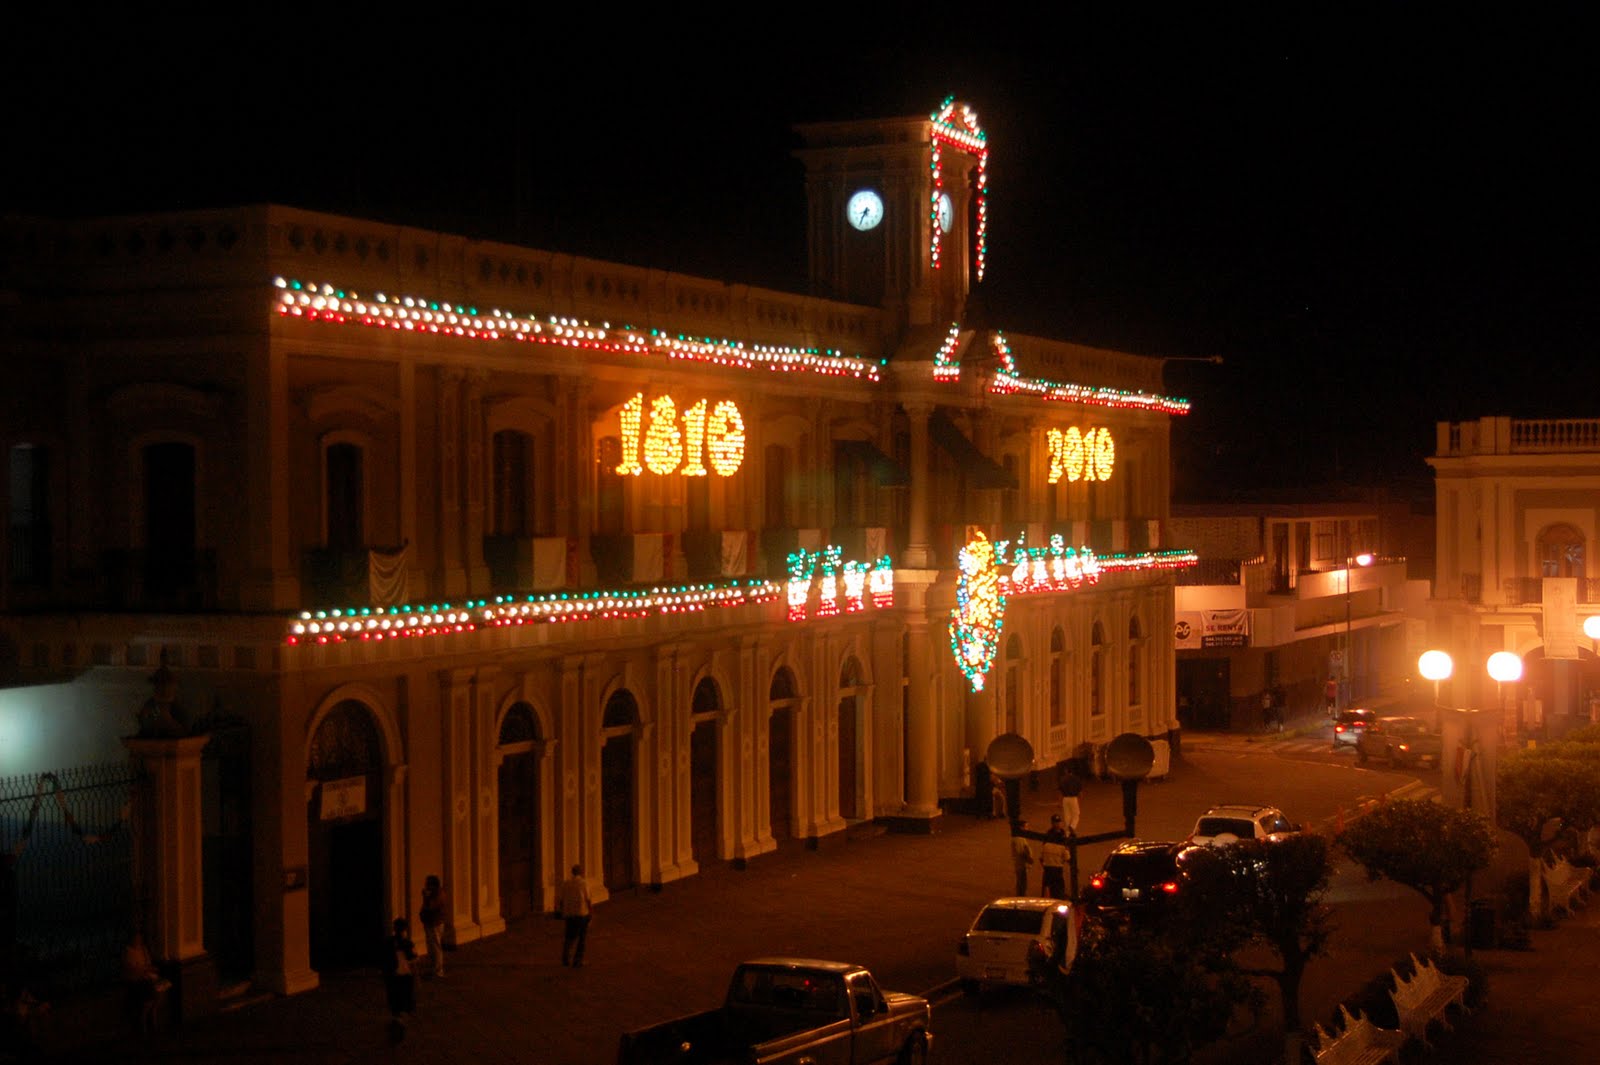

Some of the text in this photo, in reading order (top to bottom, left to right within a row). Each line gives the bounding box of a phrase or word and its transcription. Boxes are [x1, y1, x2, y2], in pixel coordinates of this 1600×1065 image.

[615, 392, 745, 476] 1810
[1046, 426, 1114, 484] 2010
[1217, 624, 1243, 632] RENTA
